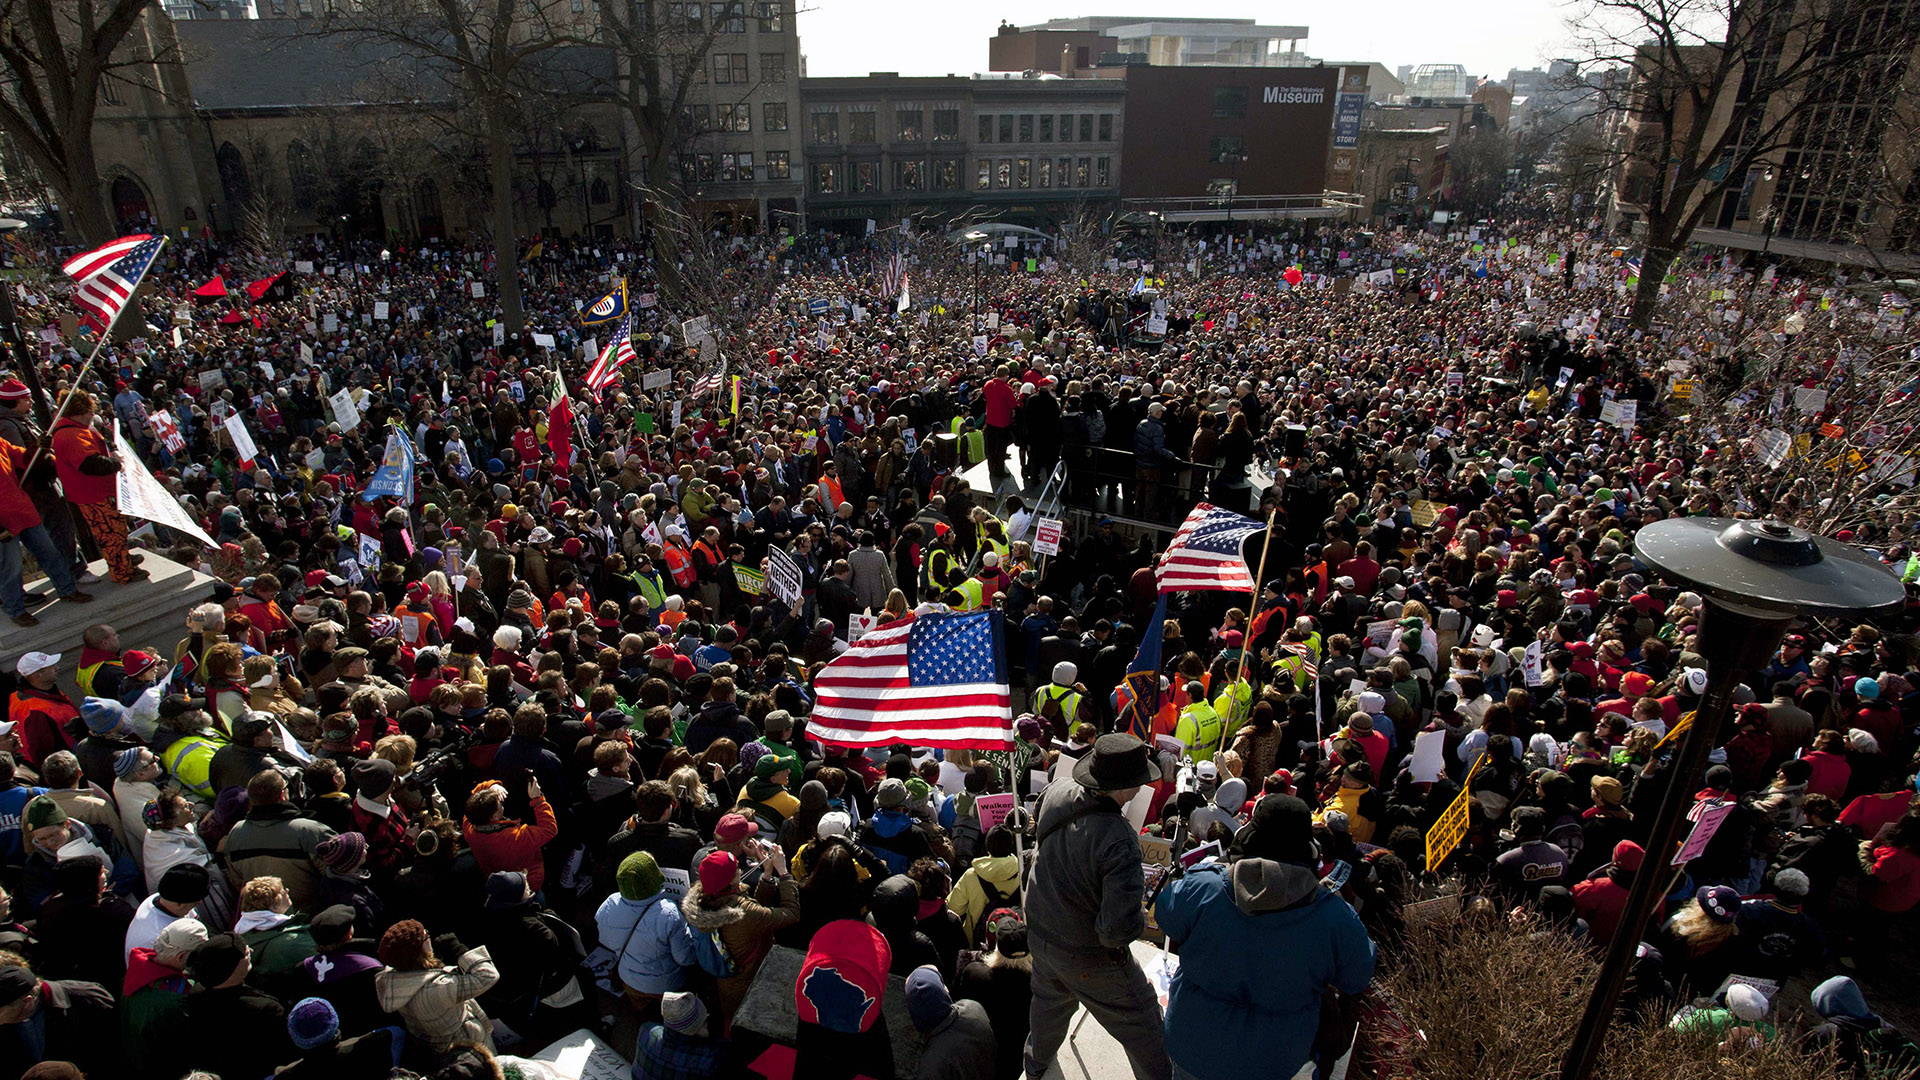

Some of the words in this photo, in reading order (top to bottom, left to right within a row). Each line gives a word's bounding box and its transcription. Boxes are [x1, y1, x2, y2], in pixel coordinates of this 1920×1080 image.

[1263, 86, 1324, 104] Museum
[1340, 115, 1359, 123] MORE
[1040, 529, 1059, 537] WRONG
[734, 572, 765, 590] WIRCH
[769, 579, 784, 600] WILL
[770, 564, 797, 598] NEITHER
[1451, 804, 1466, 829] SIDE
[1442, 829, 1455, 857] YOU
[1523, 864, 1562, 880] Rams
[666, 877, 686, 886] ank
[665, 887, 681, 895] ou
